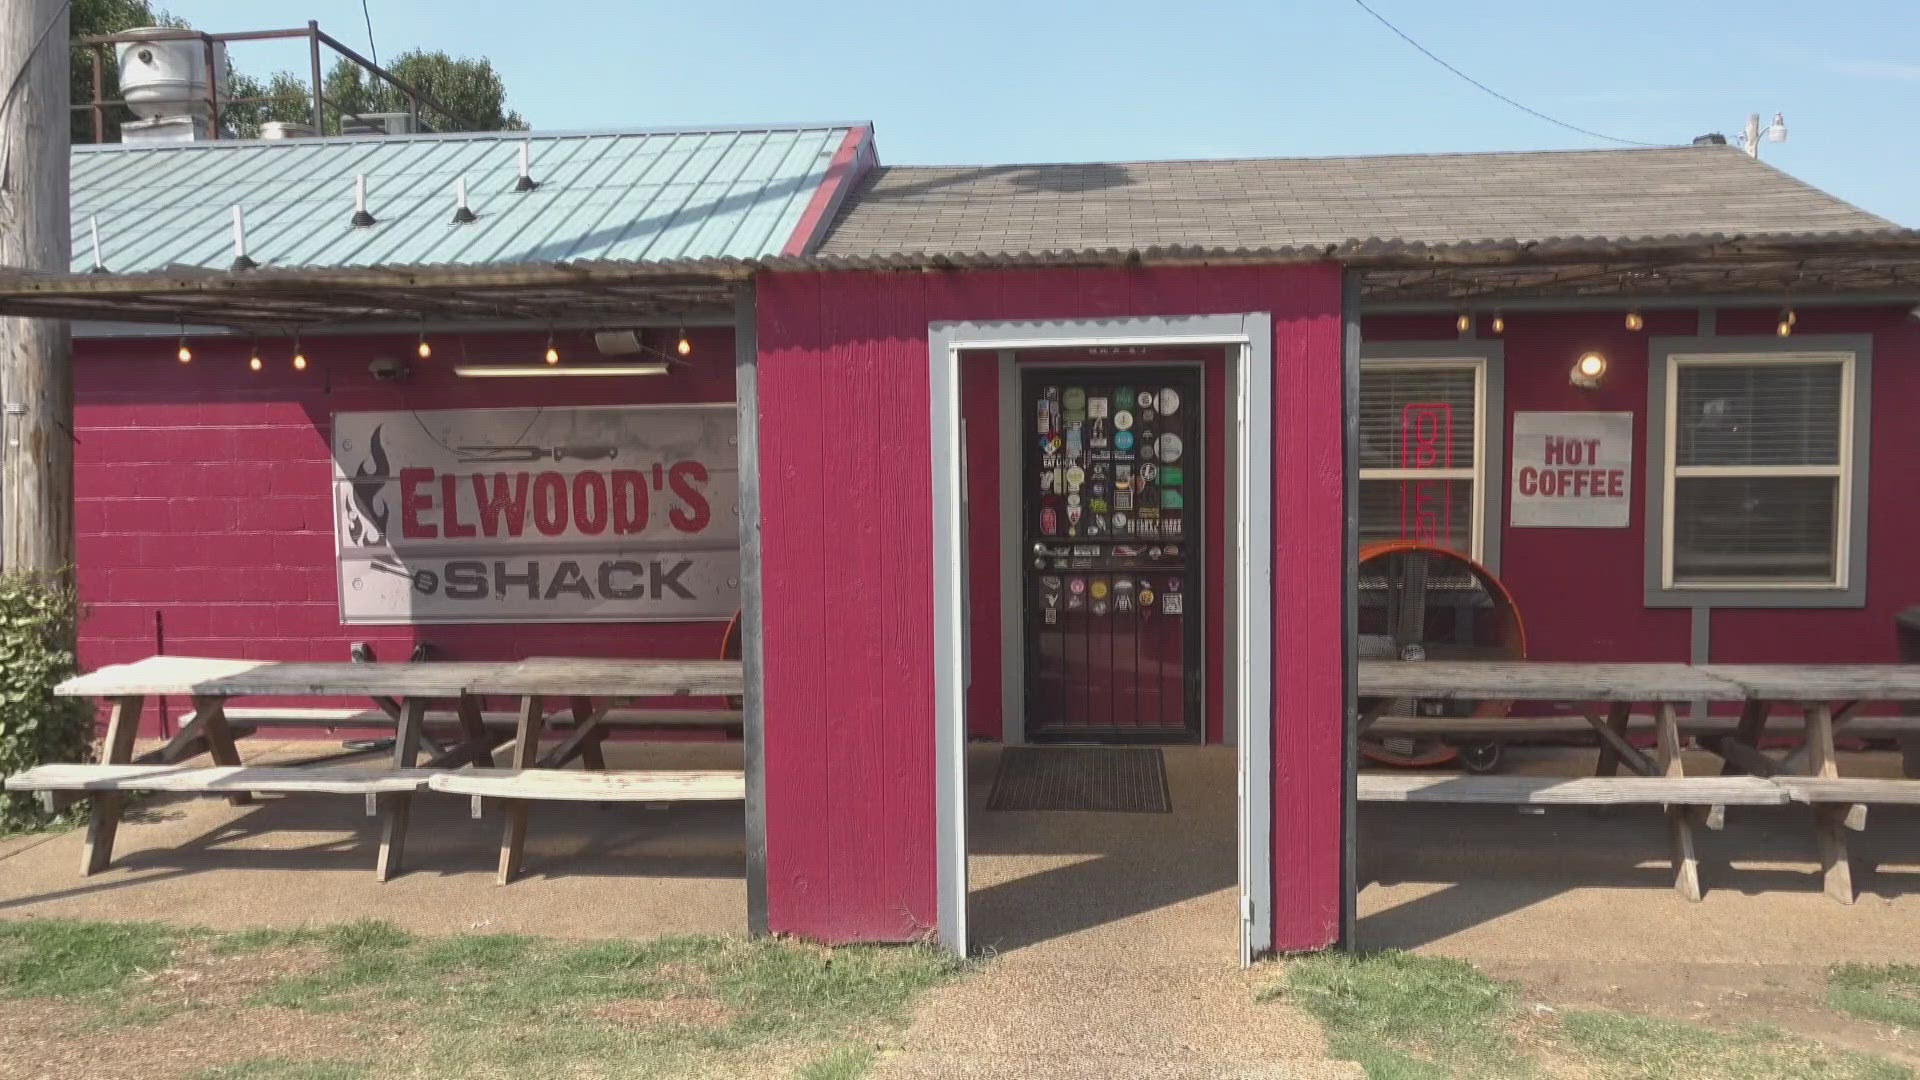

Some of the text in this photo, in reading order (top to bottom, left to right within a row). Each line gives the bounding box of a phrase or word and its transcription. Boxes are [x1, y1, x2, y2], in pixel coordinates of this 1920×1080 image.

[1545, 435, 1601, 466] HOT
[1415, 411, 1438, 545] OPEN
[1519, 466, 1625, 497] COFFEE
[399, 460, 712, 539] ELWOOD'S
[443, 560, 698, 601] SHACK
